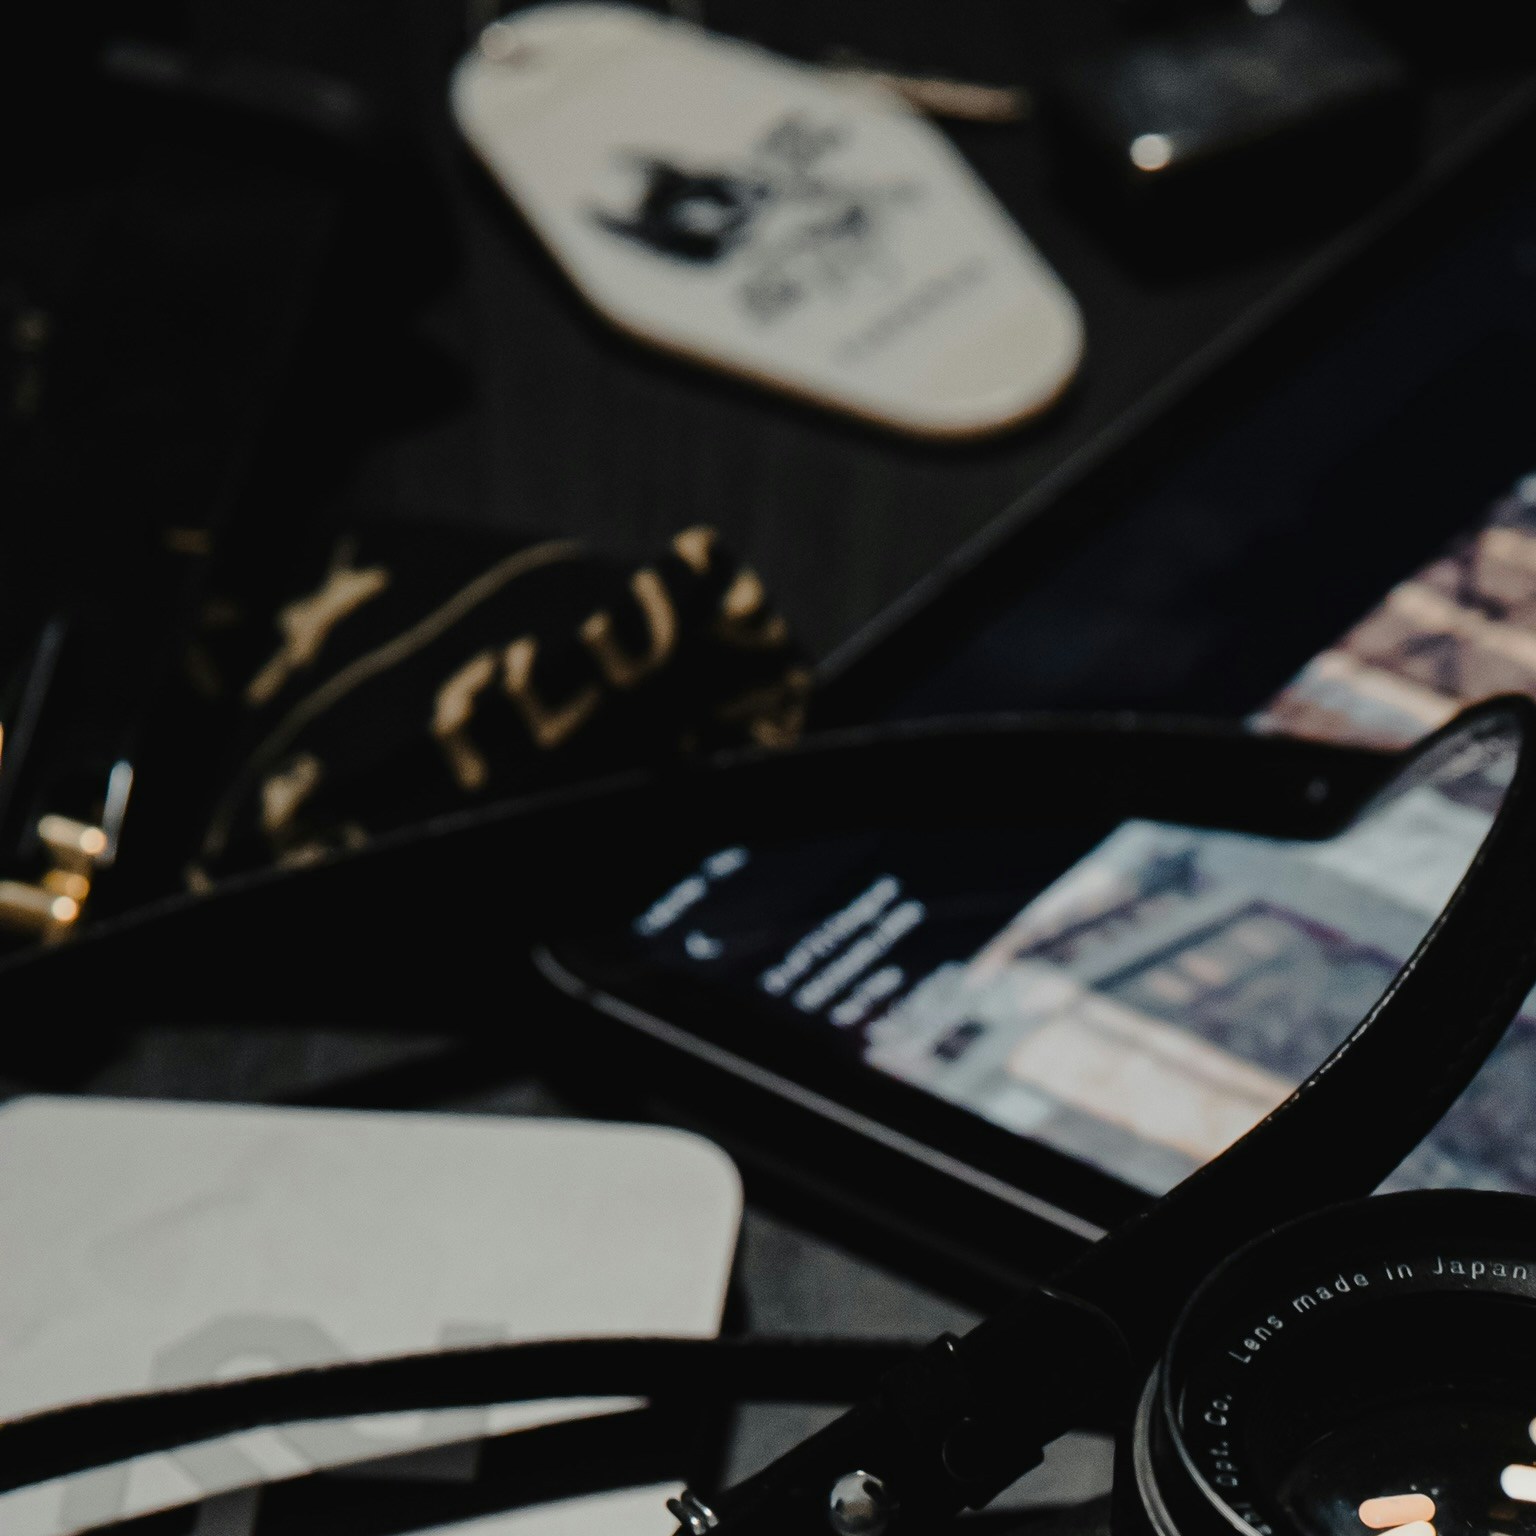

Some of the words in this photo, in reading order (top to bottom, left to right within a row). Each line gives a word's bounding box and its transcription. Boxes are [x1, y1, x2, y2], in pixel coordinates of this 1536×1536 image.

[1228, 1313, 1284, 1364] Lens
[1291, 1271, 1369, 1313] made
[1384, 1261, 1414, 1280] in
[1432, 1256, 1528, 1281] Japan
